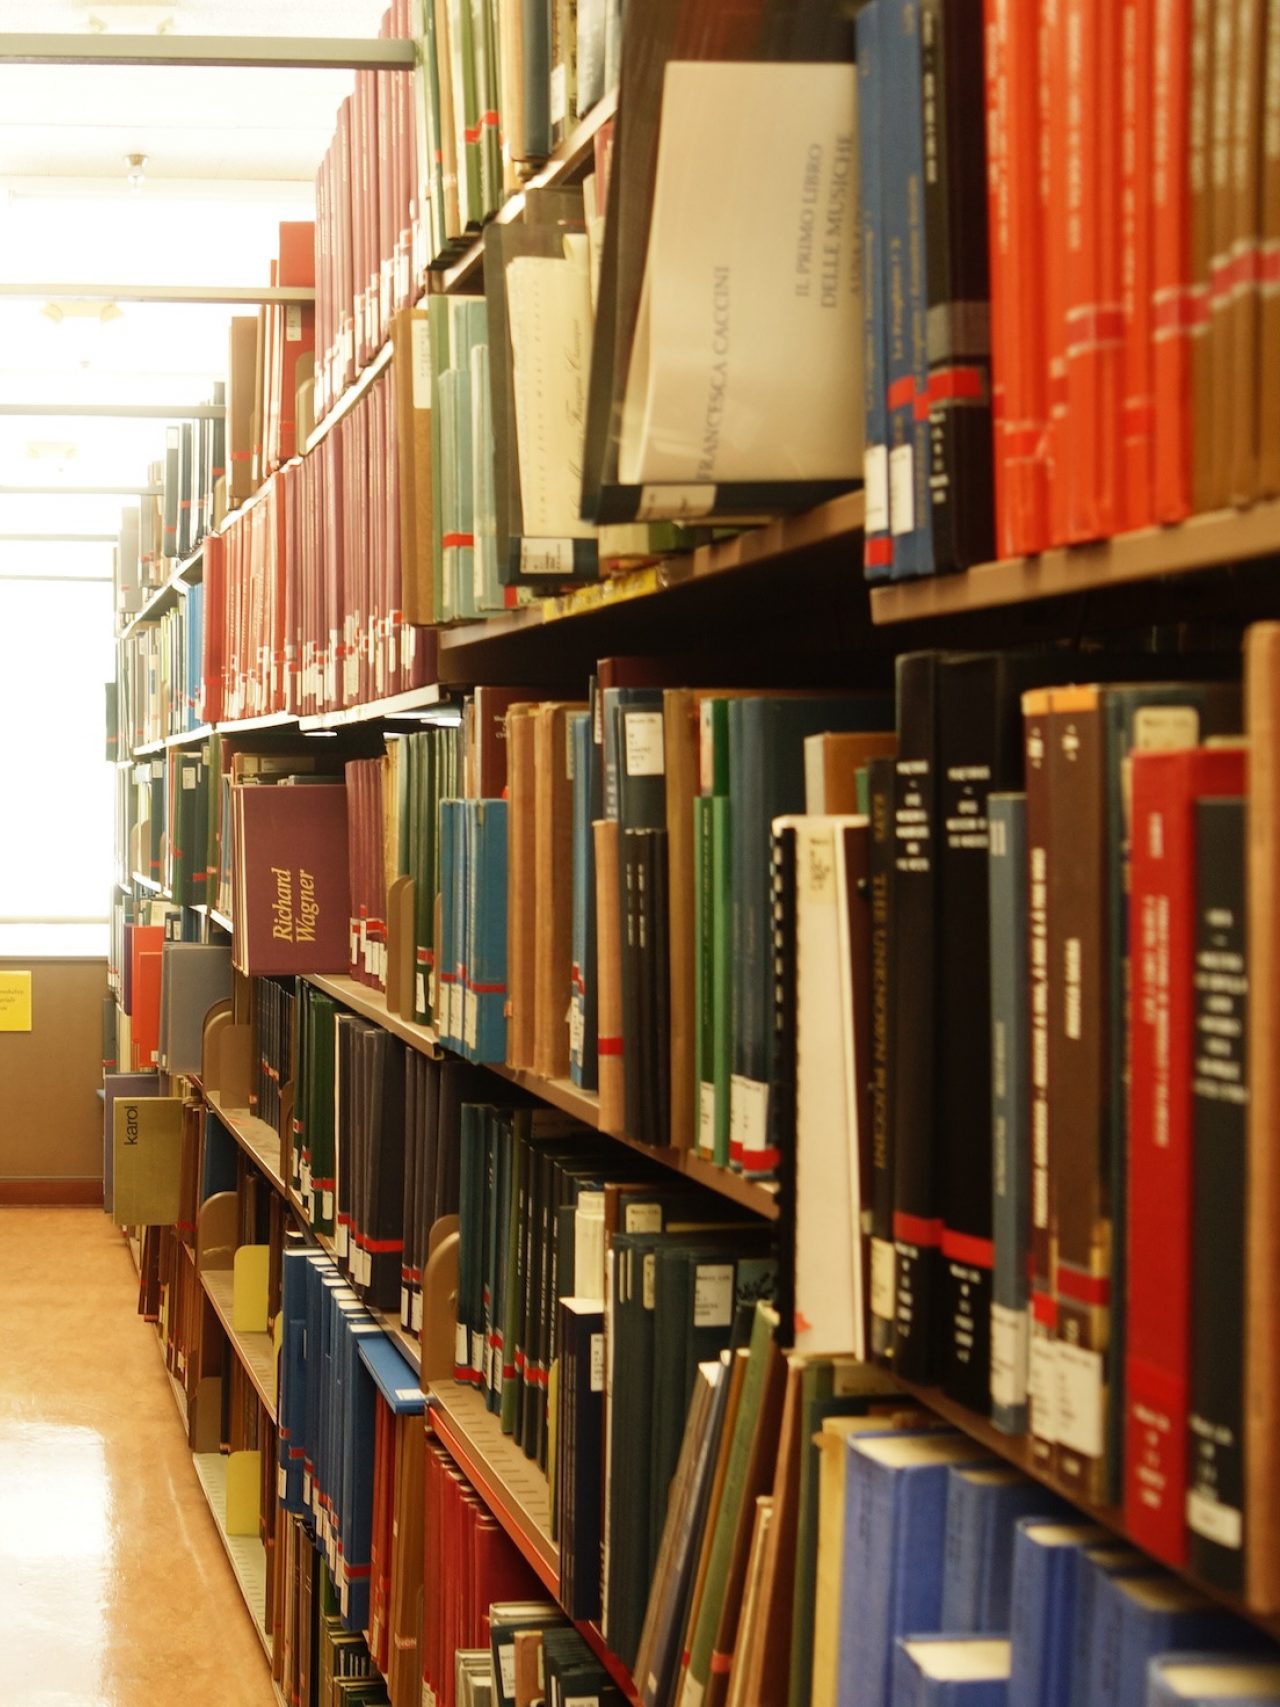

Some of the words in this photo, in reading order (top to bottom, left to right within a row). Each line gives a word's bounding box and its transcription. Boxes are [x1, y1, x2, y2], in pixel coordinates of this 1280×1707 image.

[802, 142, 822, 204] LIBRO
[825, 132, 853, 237] MUSICHE
[795, 209, 815, 274] PRIMO
[820, 243, 839, 309] DELLE
[795, 279, 810, 297] IL
[696, 361, 728, 482] FRANCESCA
[712, 265, 730, 356] CACCINI
[271, 867, 294, 944] Richard
[295, 868, 319, 942] Wagner
[873, 873, 887, 922] THE
[873, 931, 888, 1062] UNKNOWN
[123, 1105, 137, 1145] karol
[873, 1069, 887, 1169] PUCCINI
